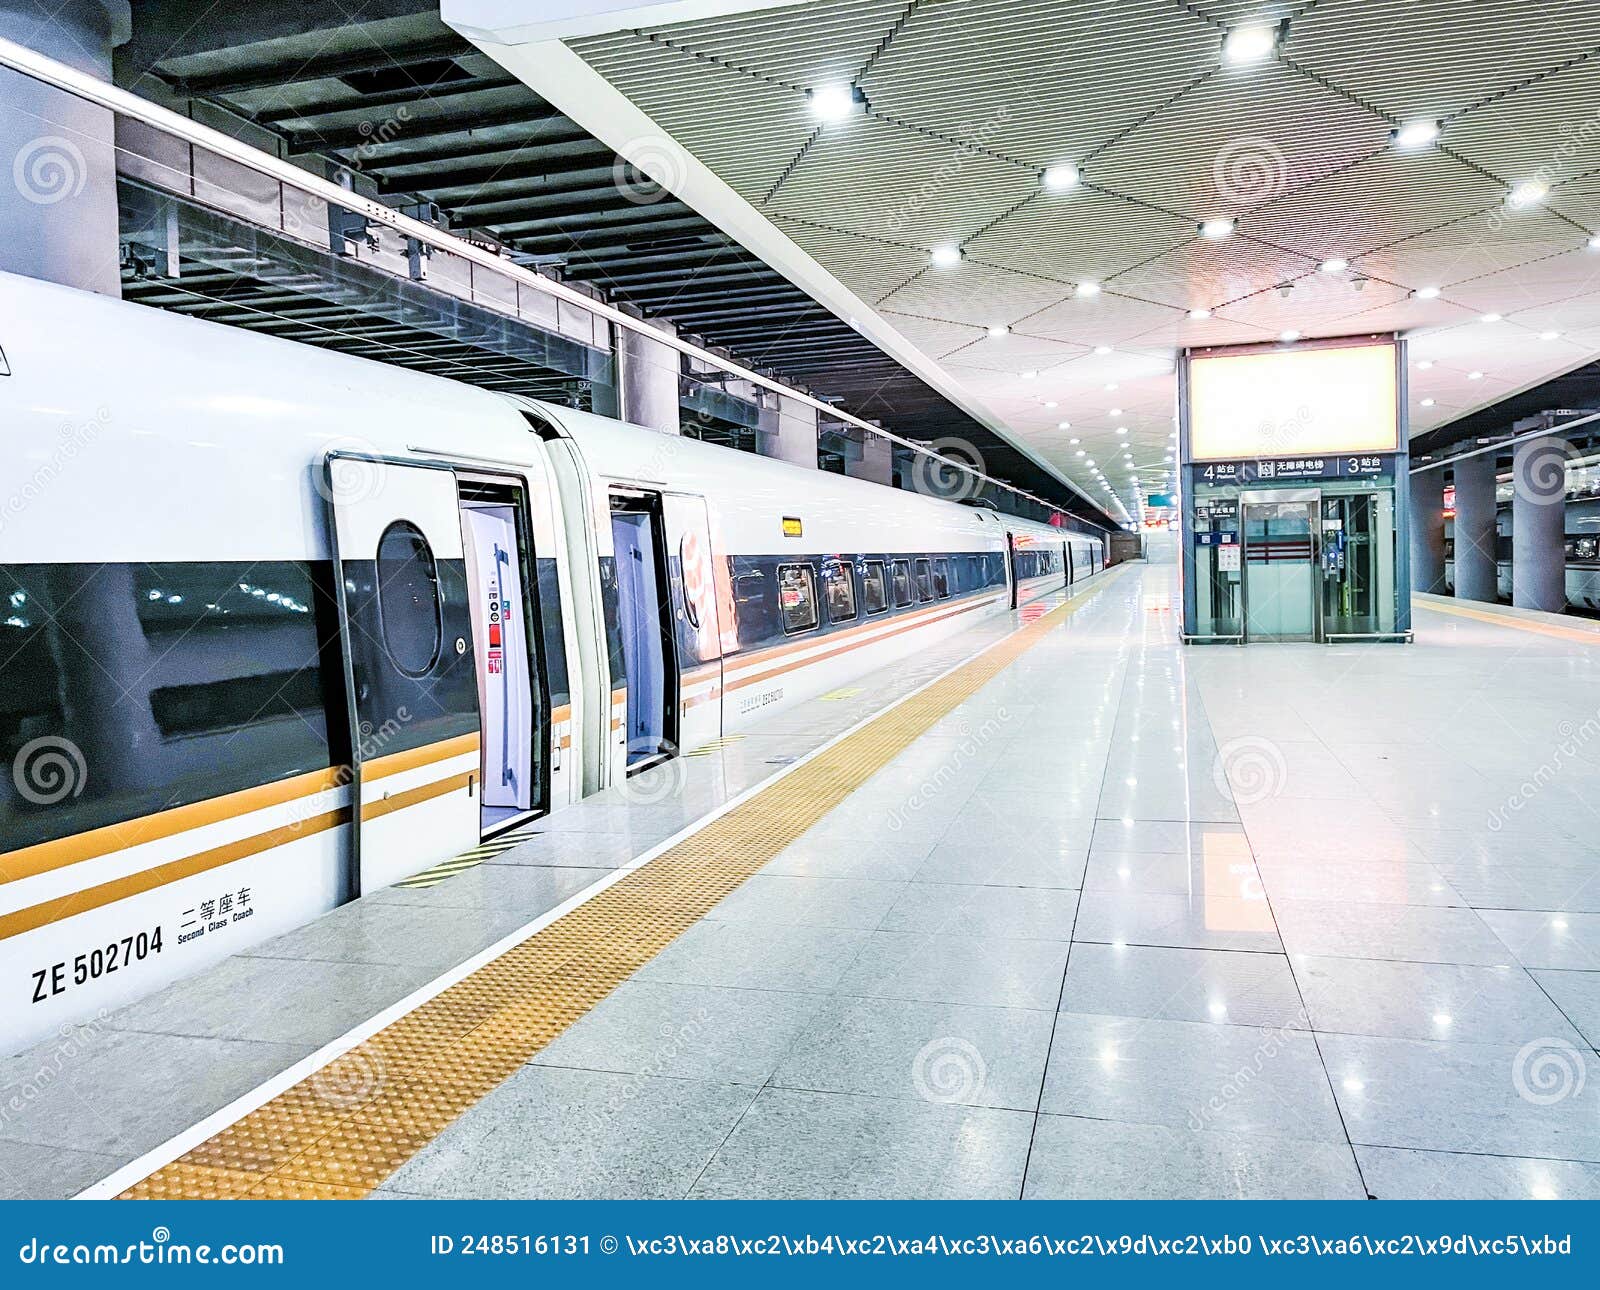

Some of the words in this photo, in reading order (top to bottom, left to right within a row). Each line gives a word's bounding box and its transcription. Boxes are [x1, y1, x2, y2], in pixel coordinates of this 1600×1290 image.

[1216, 464, 1235, 474] 站台
[1347, 457, 1359, 473] 3
[1361, 457, 1381, 466] 站台
[1203, 465, 1215, 480] 4
[181, 887, 251, 928] 二等座车
[177, 926, 205, 945] Second
[208, 917, 228, 933] Class
[232, 907, 254, 923] Coach
[31, 962, 66, 1004] ZE
[74, 925, 163, 985] 502704
